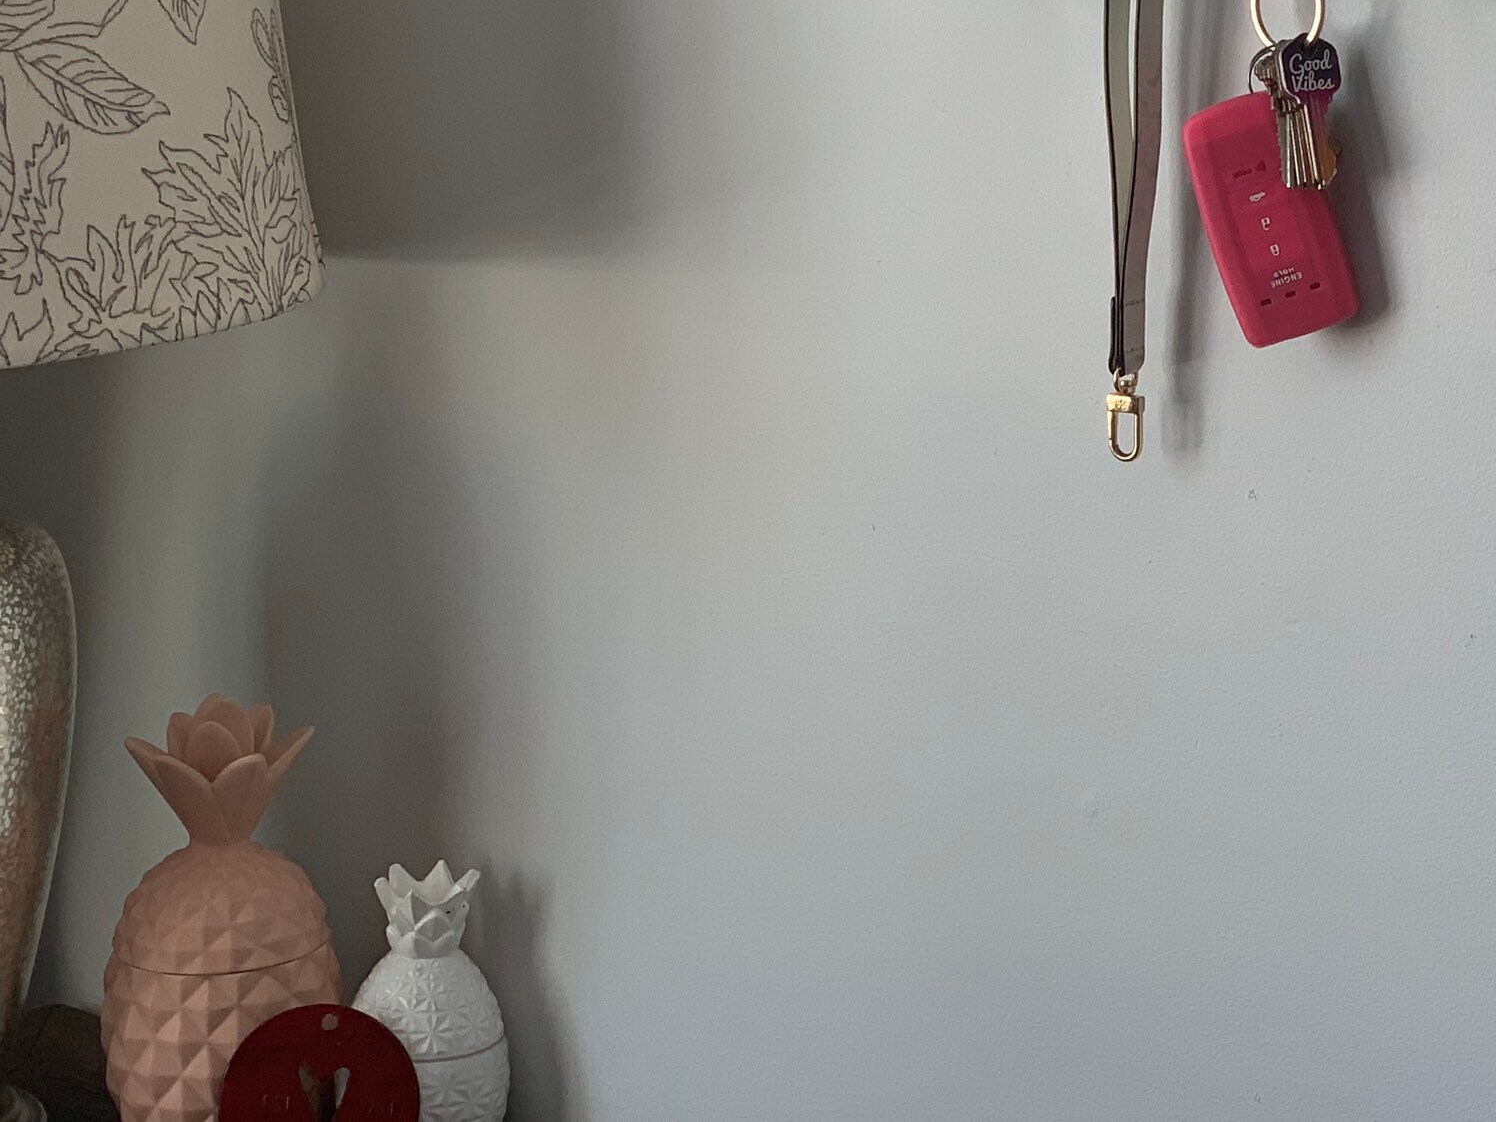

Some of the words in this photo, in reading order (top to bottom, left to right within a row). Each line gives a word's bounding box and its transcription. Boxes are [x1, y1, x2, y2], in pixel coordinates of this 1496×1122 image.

[1289, 50, 1332, 74] Good
[1292, 72, 1335, 92] Vibes
[1270, 272, 1303, 288] ENGINE
[1273, 267, 1294, 278] HOLD
